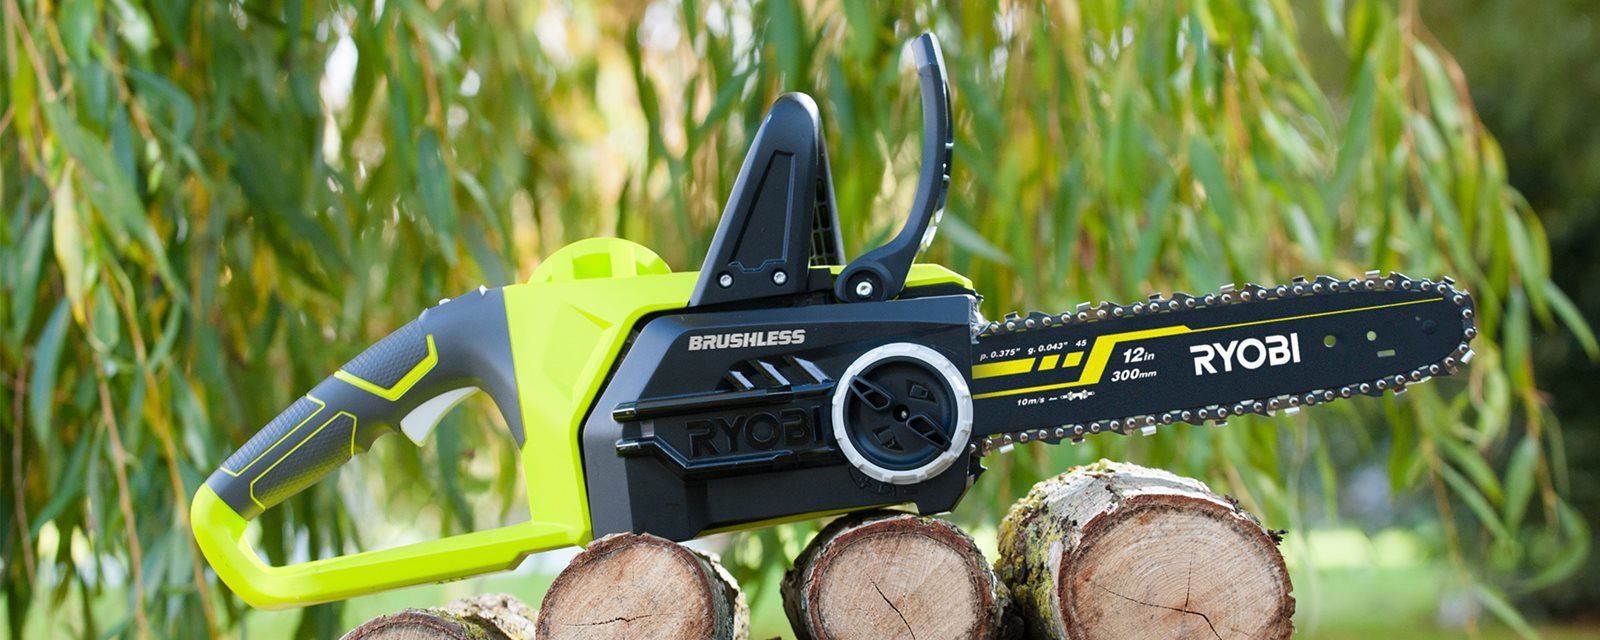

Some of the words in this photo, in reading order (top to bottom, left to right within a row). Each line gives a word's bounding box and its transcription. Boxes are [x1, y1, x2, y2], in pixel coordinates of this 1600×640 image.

[688, 329, 806, 351] BRUSHLESS
[1075, 339, 1087, 347] 45
[1123, 346, 1155, 363] 12in
[1189, 332, 1301, 376] RYOBI
[1111, 368, 1157, 382] 300mm
[1017, 396, 1045, 406] 10m/s
[685, 406, 823, 456] RYOBI
